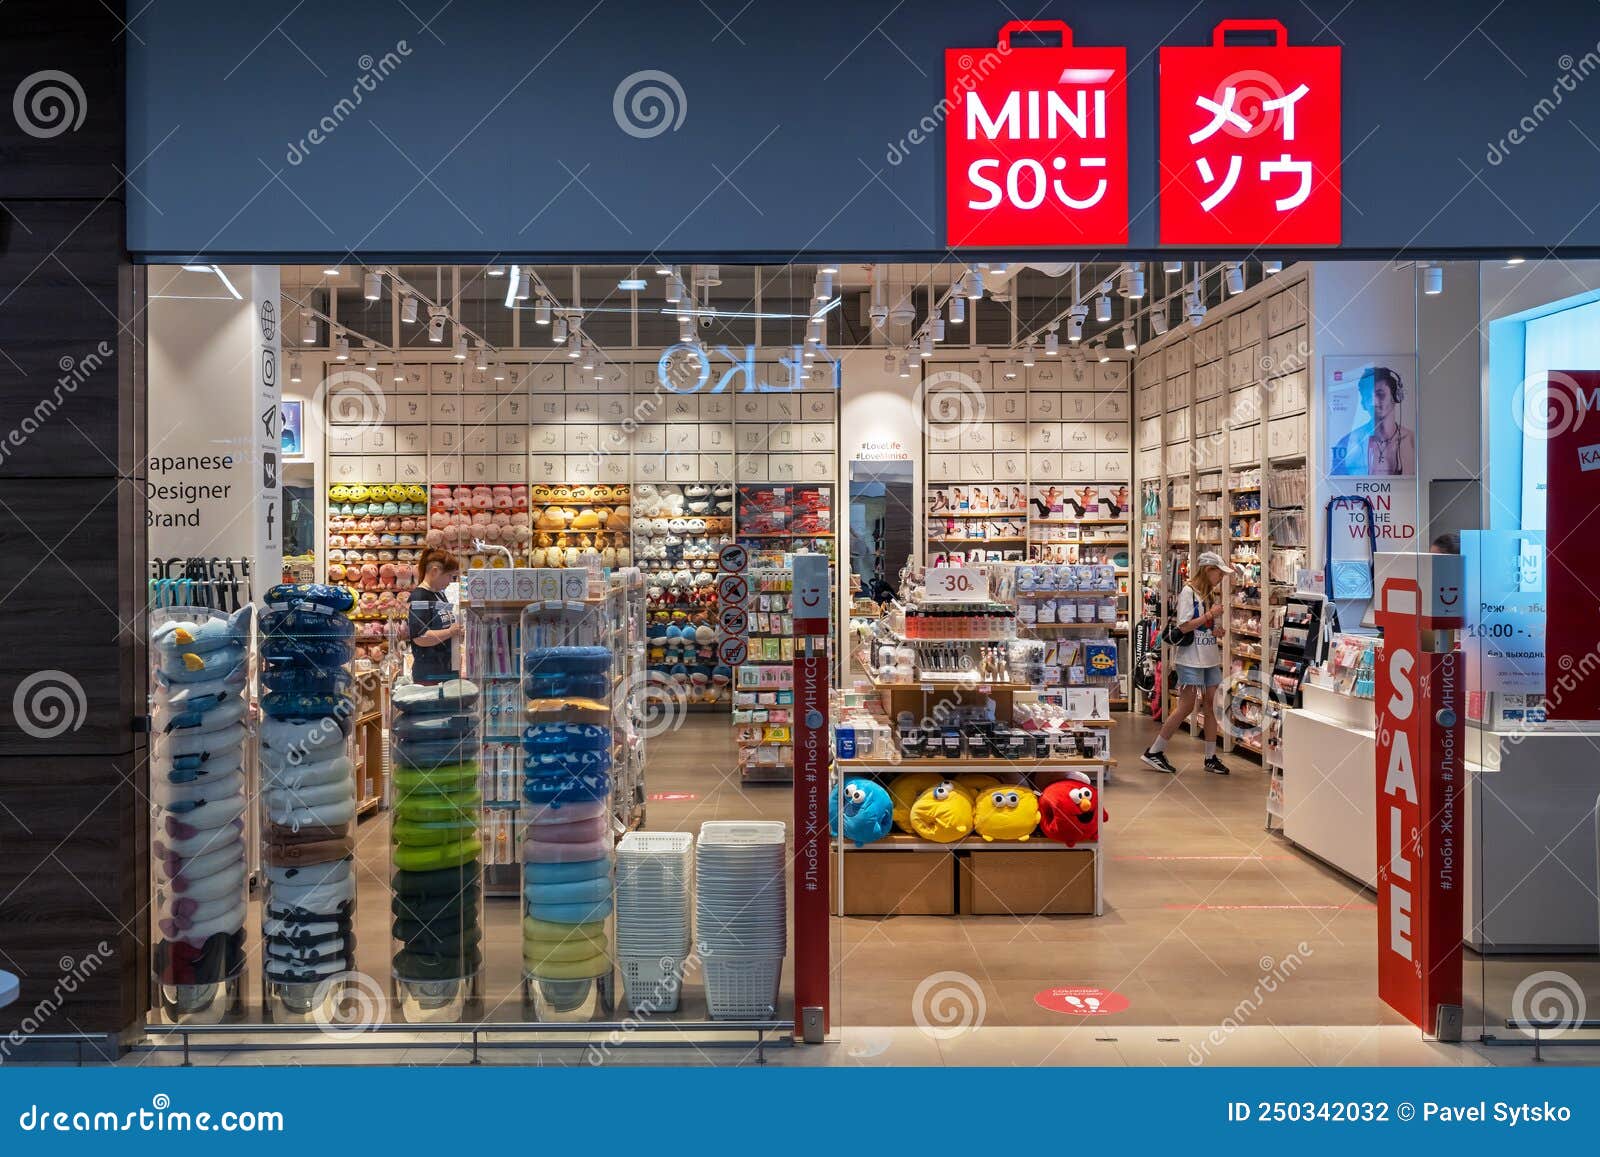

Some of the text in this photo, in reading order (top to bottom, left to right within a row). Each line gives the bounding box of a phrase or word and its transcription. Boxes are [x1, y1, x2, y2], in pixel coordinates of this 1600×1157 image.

[966, 90, 1106, 140] MINI
[1188, 83, 1310, 145] メイ
[1193, 154, 1314, 212] ソウ
[150, 456, 233, 475] apanese
[148, 482, 231, 503] Designer
[1356, 483, 1391, 493] FROM
[1349, 513, 1390, 523] TO HE
[1349, 525, 1415, 538] WORLD
[1467, 623, 1513, 637] 10:00
[1441, 654, 1454, 711] ИНИСО
[805, 657, 818, 891] #Люби Жизнь #Люби ИНИСО
[1384, 648, 1418, 961] SALE
